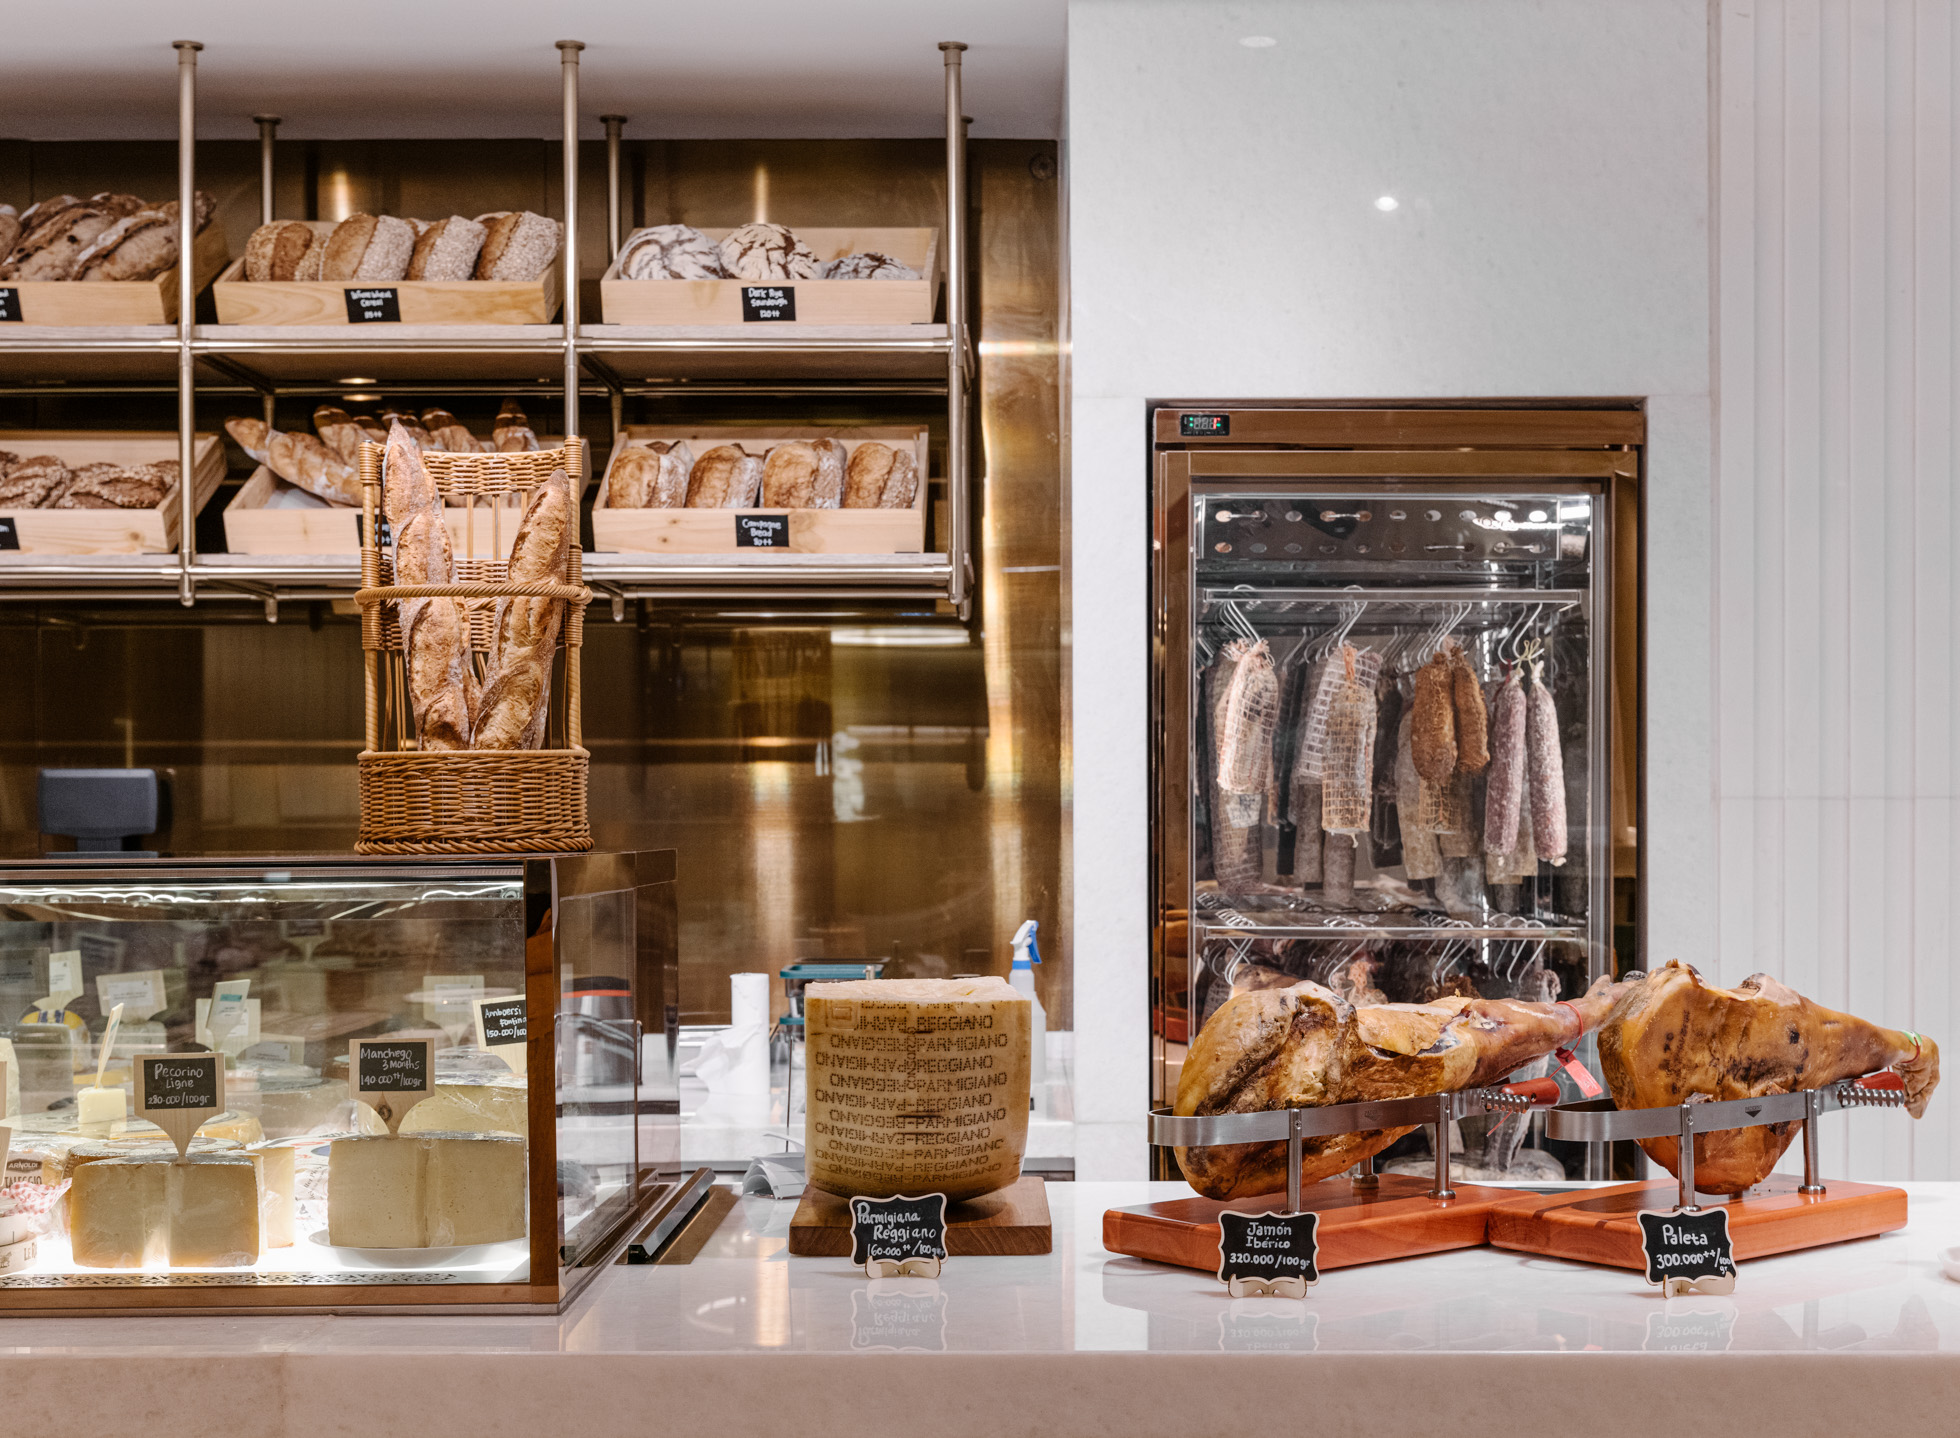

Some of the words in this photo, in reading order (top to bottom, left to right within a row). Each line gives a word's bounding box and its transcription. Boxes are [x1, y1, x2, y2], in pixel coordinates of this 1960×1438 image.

[748, 288, 767, 298] Dark
[750, 527, 773, 537] Bread
[917, 1014, 993, 1031] REGGIANO
[917, 1033, 1008, 1052] PARMIGIANO
[360, 1047, 413, 1061] Manchego
[154, 1063, 204, 1080] Pecorino
[382, 1059, 389, 1071] 3
[389, 1060, 420, 1070] Months
[917, 1055, 993, 1073] REGGIANO
[917, 1072, 1008, 1093] PARMIGIANO
[8, 1161, 38, 1170] ARNOLDI
[857, 1202, 920, 1229] Parmigiana
[873, 1224, 937, 1243] Reggiano
[1246, 1222, 1292, 1236] Jamón
[1662, 1224, 1708, 1245] Paleta
[1245, 1236, 1291, 1249] Ibérico
